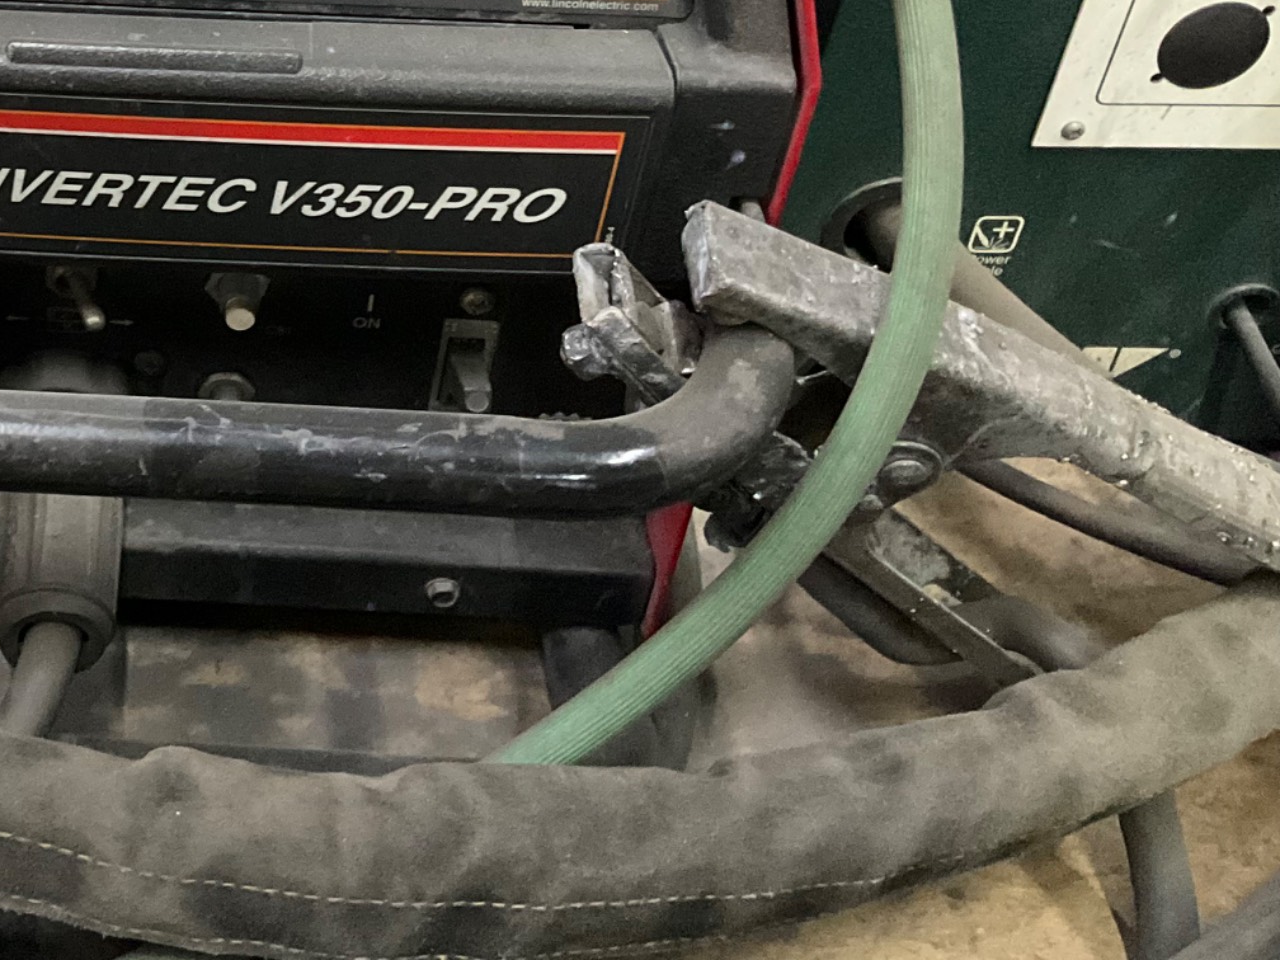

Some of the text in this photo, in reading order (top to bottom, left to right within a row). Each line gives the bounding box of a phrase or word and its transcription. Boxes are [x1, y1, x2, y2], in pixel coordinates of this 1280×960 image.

[269, 180, 568, 224] V350-PRO
[977, 255, 1012, 265] ower
[352, 316, 382, 329] ON
